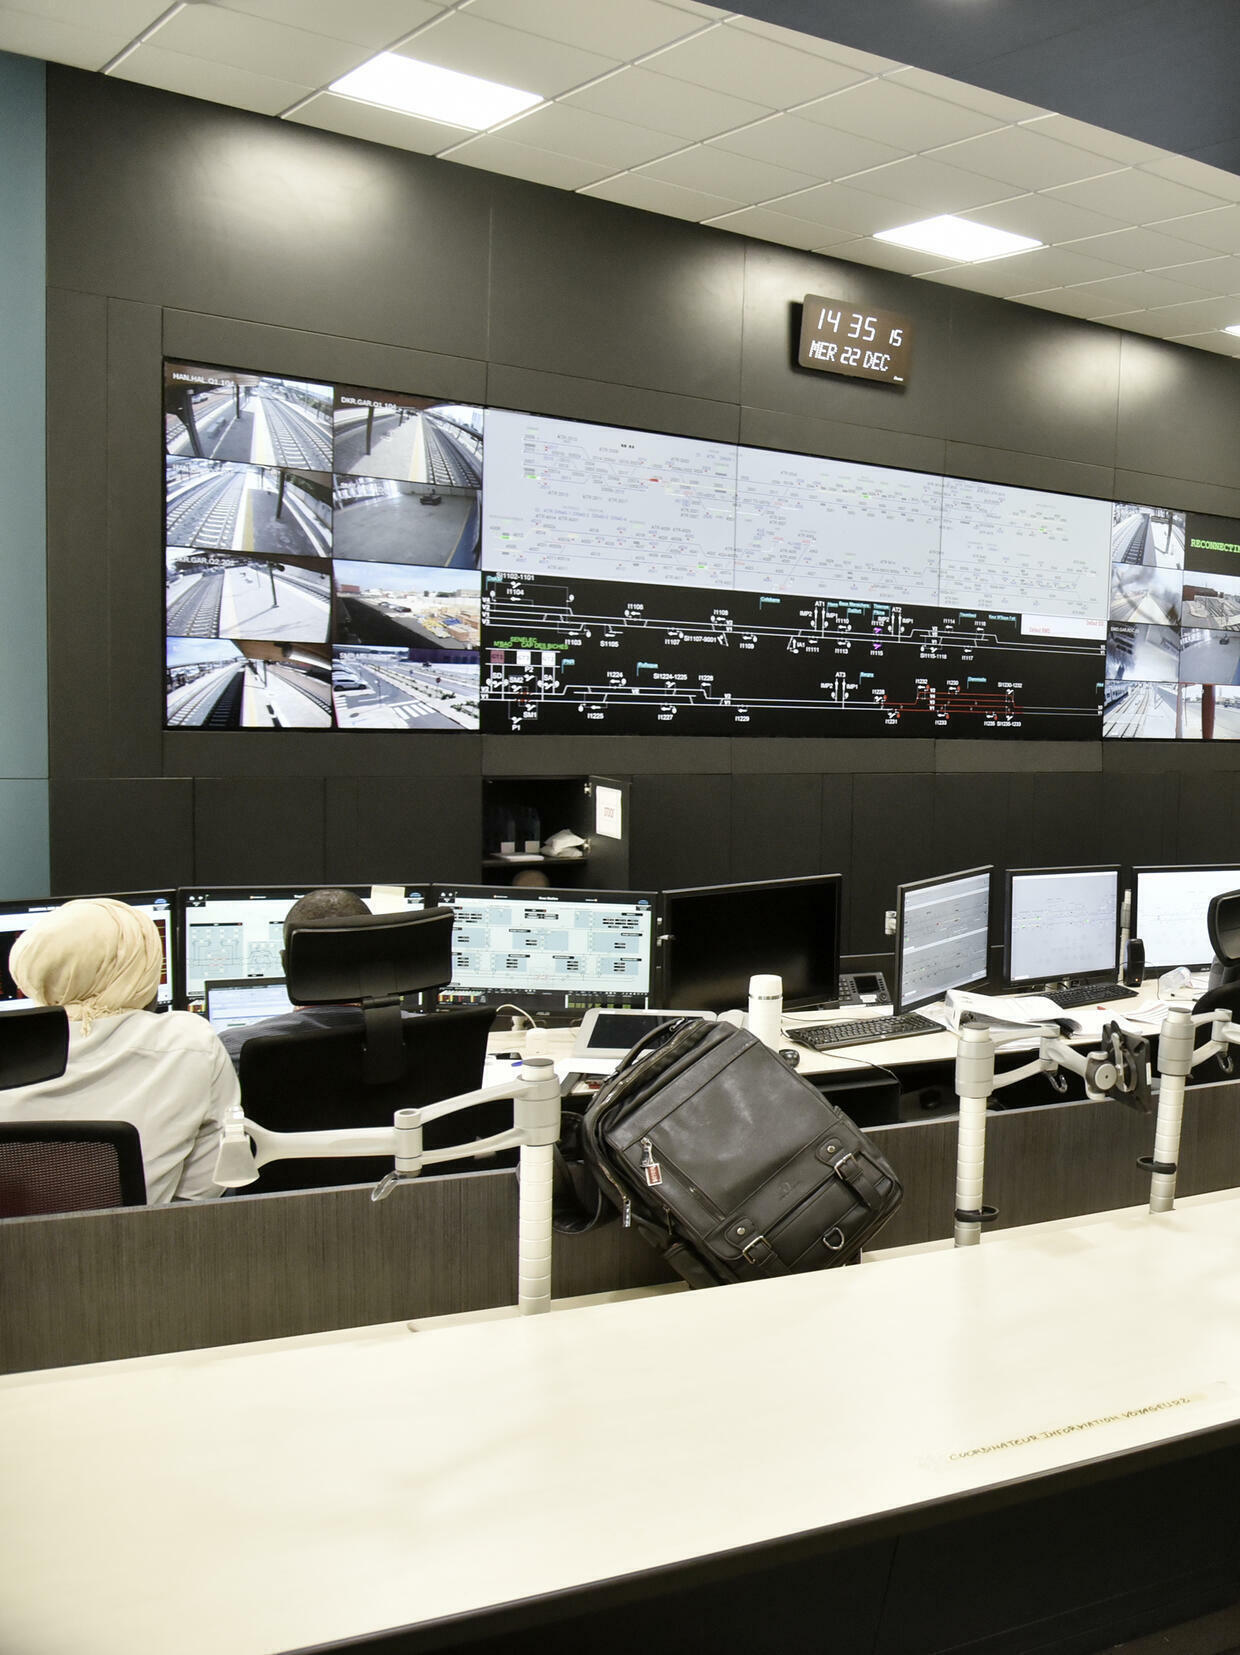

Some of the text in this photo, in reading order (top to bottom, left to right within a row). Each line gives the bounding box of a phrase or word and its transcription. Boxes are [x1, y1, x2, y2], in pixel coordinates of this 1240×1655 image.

[817, 308, 904, 347] 14 35 15
[808, 339, 891, 372] MER 22 DEC
